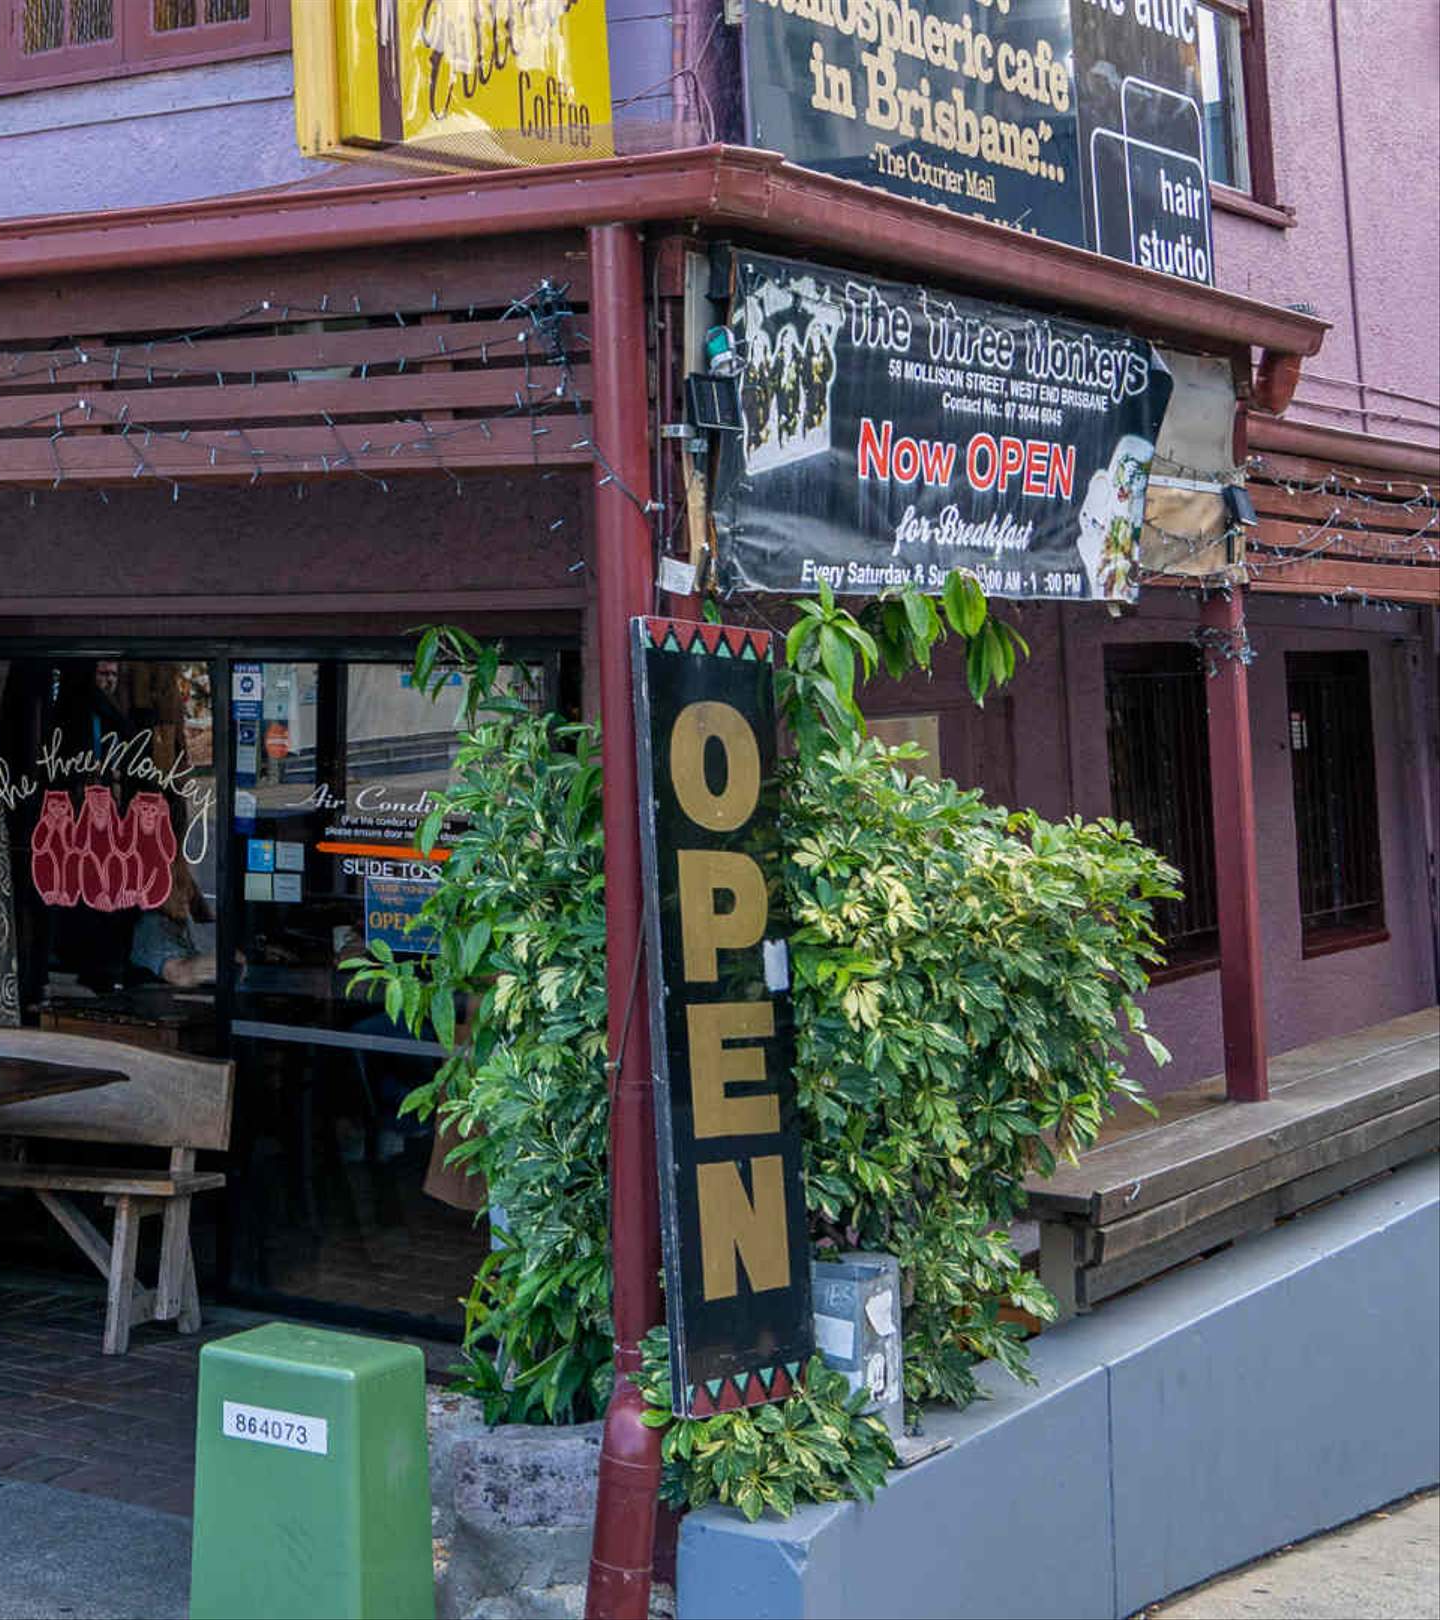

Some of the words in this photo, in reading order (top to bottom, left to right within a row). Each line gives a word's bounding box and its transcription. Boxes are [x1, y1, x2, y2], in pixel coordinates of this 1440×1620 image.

[809, 40, 858, 121] in
[996, 38, 1070, 113] cafe
[518, 70, 592, 149] Coffee
[907, 151, 965, 197] Courier
[964, 168, 997, 204] Mail
[1159, 167, 1202, 220] hair
[1138, 228, 1208, 283] studio
[844, 280, 913, 353] The
[920, 289, 1017, 370] Three
[1025, 316, 1149, 404] Monkeys
[887, 358, 903, 379] 58
[903, 360, 964, 389] MOLLISION
[965, 371, 1010, 399] STREET,
[1010, 379, 1040, 401] WEST
[1039, 383, 1061, 404] END
[1061, 387, 1109, 413] BRISBANE
[941, 390, 983, 414] Contact
[857, 415, 958, 491] Now
[966, 430, 1077, 502] OPEN
[890, 503, 933, 557] for
[932, 503, 1034, 561] Breakfast
[1004, 571, 1022, 592] AM
[1064, 573, 1082, 594] PM
[285, 782, 346, 810] Air
[341, 858, 395, 878] SLIDE
[669, 699, 792, 1303] OPEN
[235, 1413, 309, 1446] 864073
